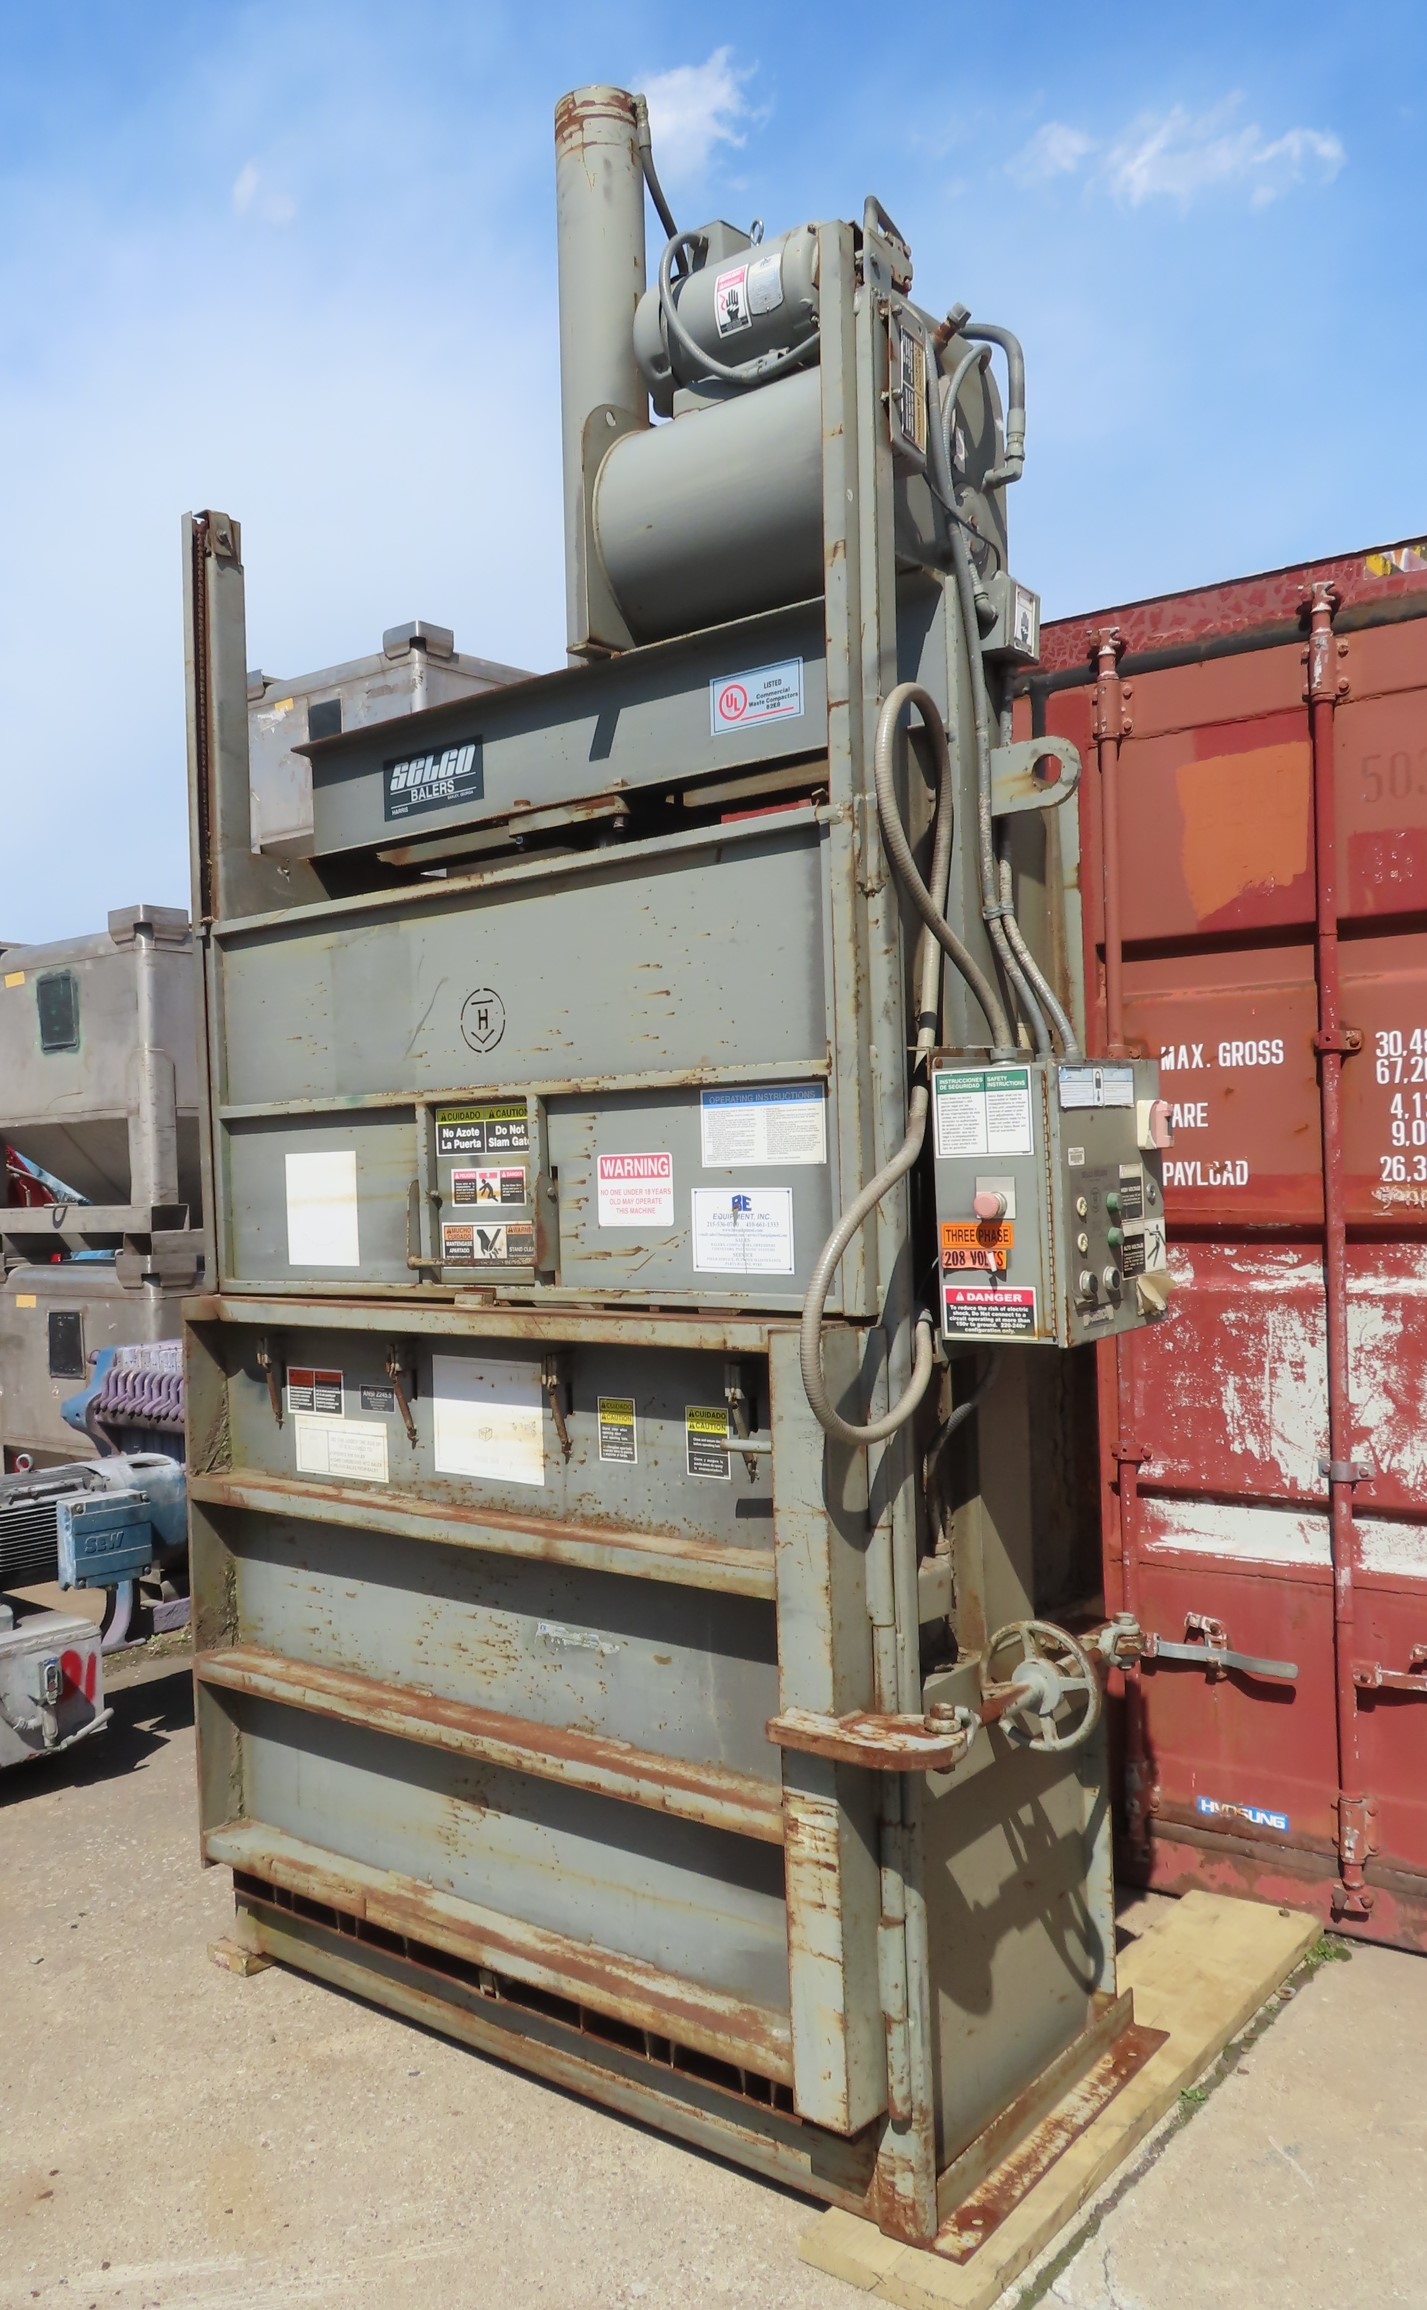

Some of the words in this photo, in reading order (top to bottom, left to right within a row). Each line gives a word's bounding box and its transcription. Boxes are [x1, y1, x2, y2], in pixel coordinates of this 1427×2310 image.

[764, 679, 782, 689] LISTED
[756, 687, 790, 699] Commercial
[766, 692, 798, 704] Compactors
[726, 693, 740, 712] UL
[390, 744, 476, 791] SELCO
[410, 780, 455, 802] BALERS
[1160, 1044, 1211, 1070] MAX.
[1218, 1039, 1284, 1066] GROSS
[1376, 1056, 1427, 1084] 67,2
[940, 1076, 983, 1085] INSTRUCCIONES
[986, 1080, 1026, 1088] INSTRUCTIONS
[709, 1094, 753, 1104] OPERATING
[755, 1090, 816, 1102] INSTRUCTIONS
[1390, 1092, 1427, 1120] 4,1
[447, 1111, 480, 1120] CUIDADO
[1171, 1102, 1208, 1128] ARE
[442, 1128, 454, 1138] No
[456, 1128, 480, 1138] Azote
[495, 1126, 507, 1136] Do
[509, 1124, 525, 1134] Not
[442, 1140, 452, 1150] La
[454, 1139, 482, 1149] Puerta
[488, 1137, 510, 1148] Slam
[602, 1157, 669, 1177] WARNING
[1162, 1160, 1249, 1186] PAYLOAD
[623, 1188, 643, 1196] UNDER
[610, 1198, 622, 1206] OLD
[946, 1229, 976, 1242] THREE
[978, 1229, 1010, 1242] PHASE
[944, 1250, 966, 1266] 208
[966, 1292, 1022, 1302] DANGER
[968, 1316, 994, 1324] operating
[606, 1414, 632, 1422] CAUTION
[695, 1410, 726, 1420] CUIDADO
[696, 1421, 726, 1431] CAUTION
[84, 1531, 124, 1554] SEW
